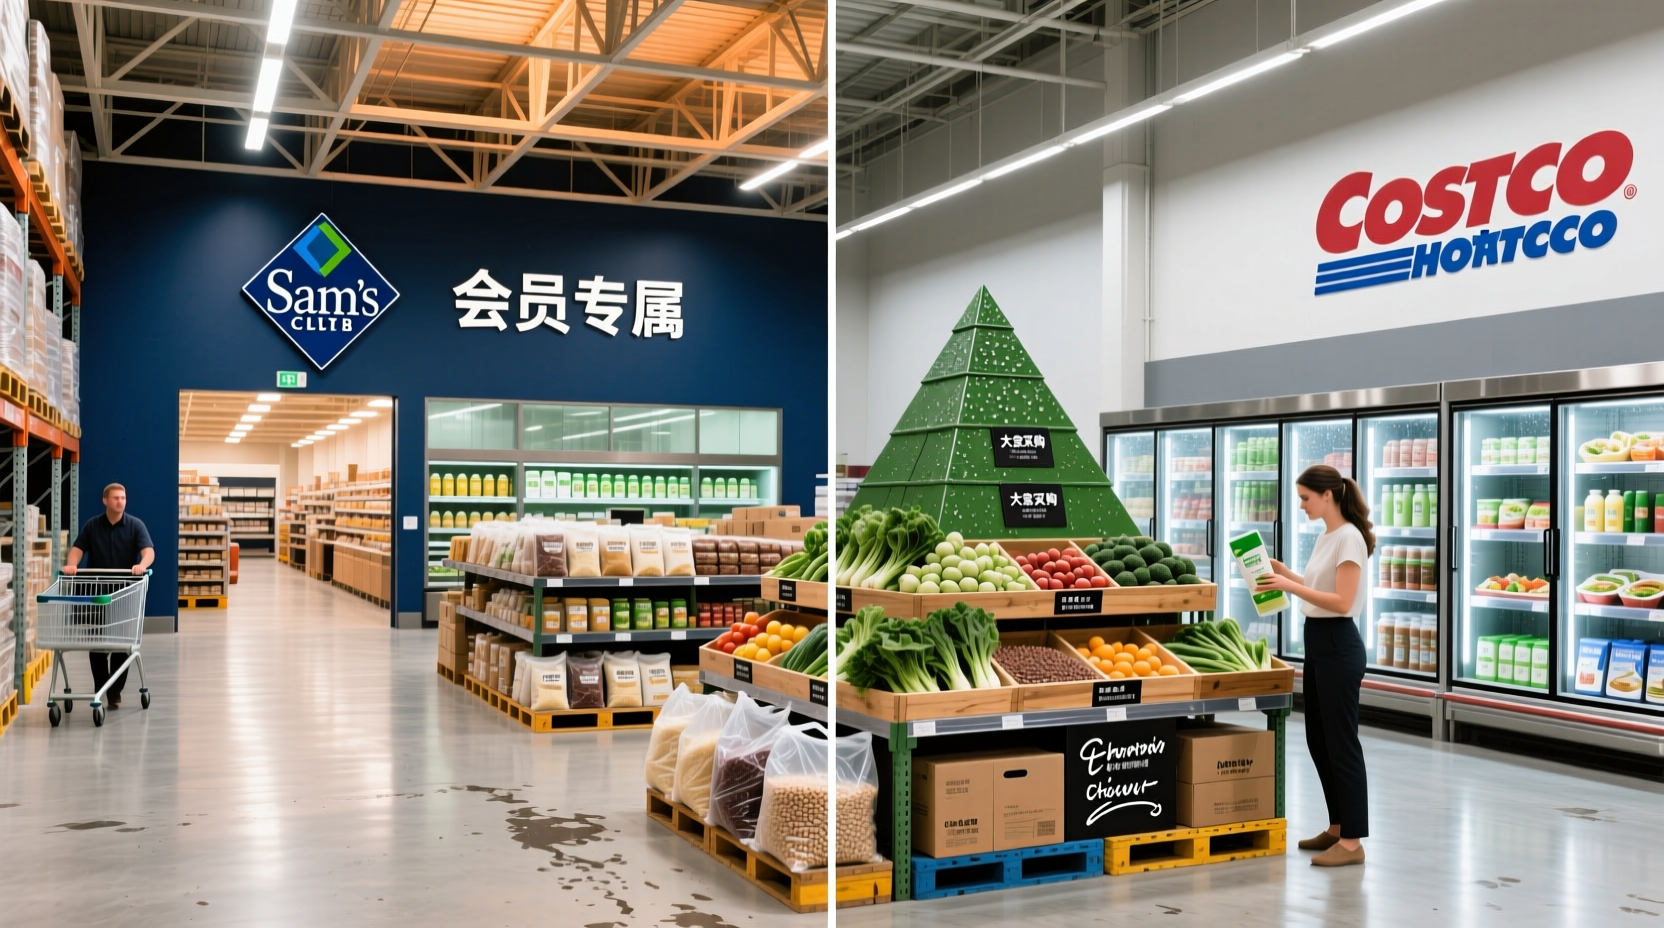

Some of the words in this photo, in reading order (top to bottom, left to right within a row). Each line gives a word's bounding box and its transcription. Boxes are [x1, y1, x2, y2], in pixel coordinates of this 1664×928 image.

[1315, 130, 1634, 254] COSTCO
[266, 268, 380, 317] Sam's
[453, 268, 684, 339] 会员专属
